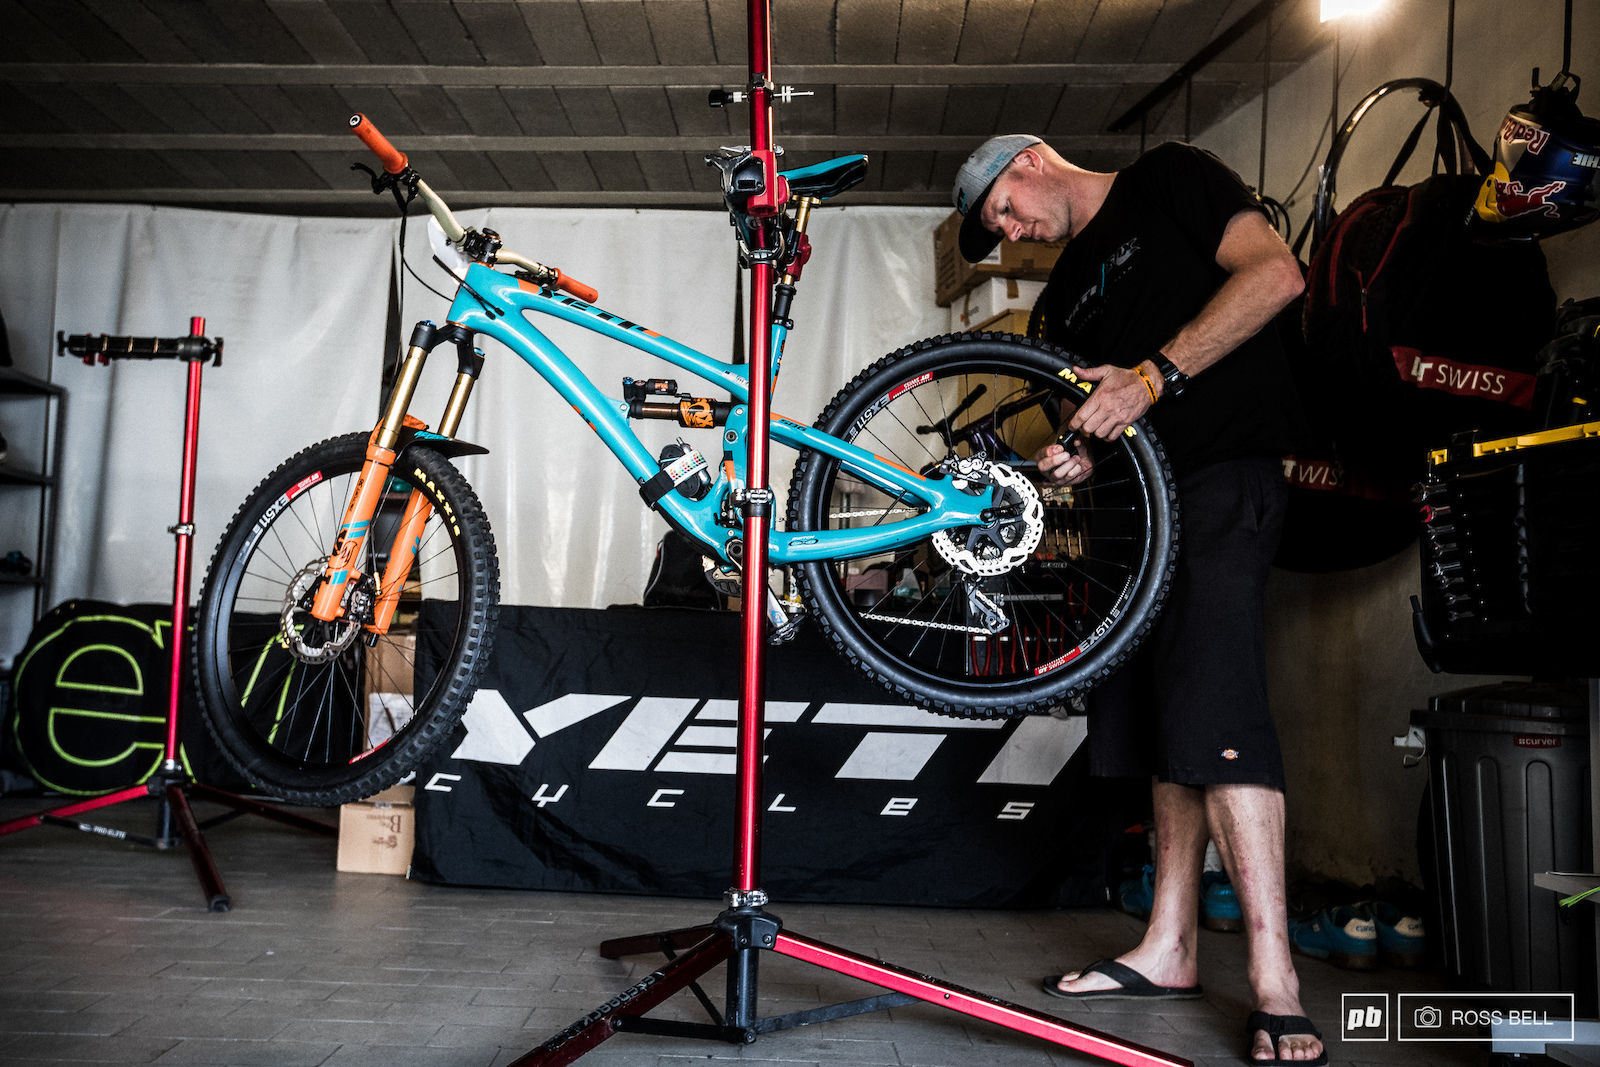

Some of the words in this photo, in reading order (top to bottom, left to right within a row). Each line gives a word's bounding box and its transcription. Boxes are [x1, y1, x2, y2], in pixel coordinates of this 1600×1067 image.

[1435, 363, 1506, 395] SWISS
[856, 394, 889, 429] EX511
[258, 493, 290, 528] EX511
[413, 467, 461, 537] MAXXIS
[1079, 616, 1114, 653] EX511
[1048, 658, 1066, 671] SWISS
[450, 688, 1088, 786] YETI
[1525, 737, 1557, 746] curver
